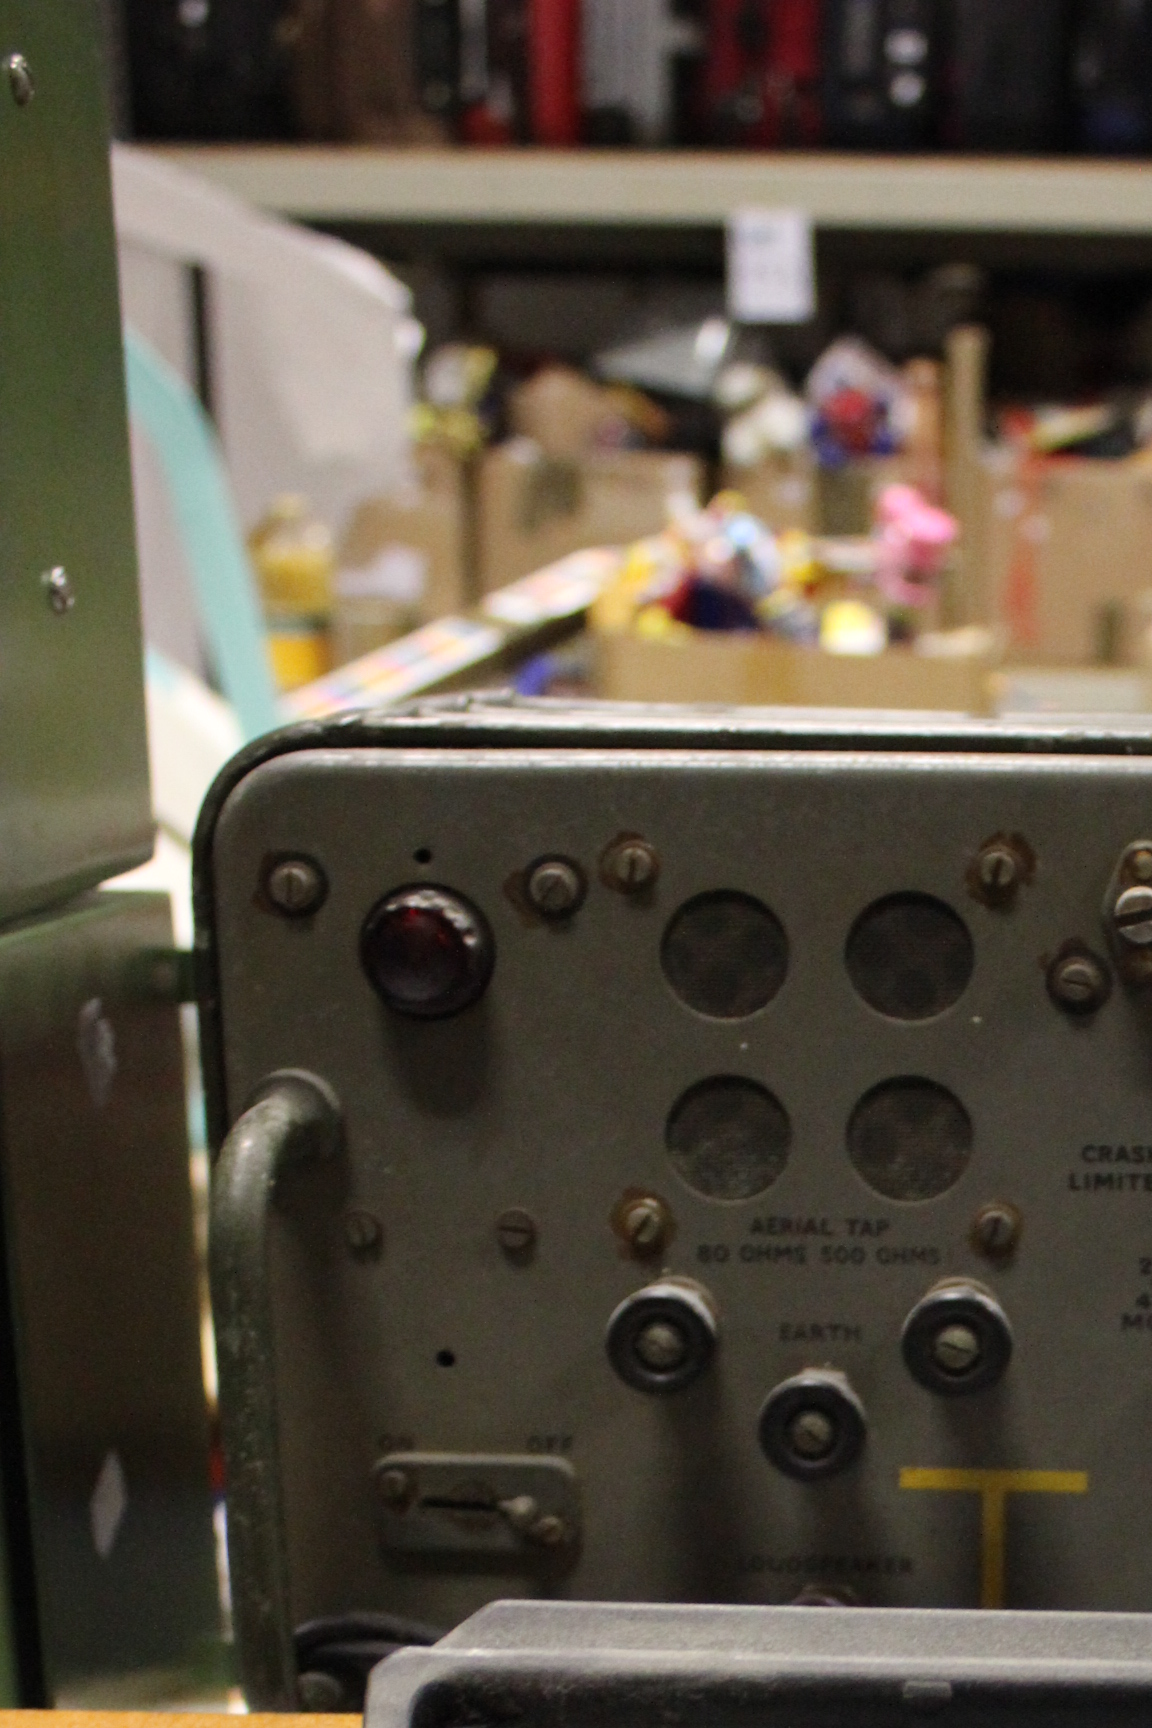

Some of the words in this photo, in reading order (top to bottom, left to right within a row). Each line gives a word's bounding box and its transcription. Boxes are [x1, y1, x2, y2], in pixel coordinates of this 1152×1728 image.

[750, 1216, 834, 1237] AERIAL
[845, 1217, 890, 1237] TAP
[738, 1244, 807, 1265] OHMS
[820, 1245, 866, 1265] 500
[875, 1246, 943, 1266] OHMS
[778, 1322, 862, 1342] EARTH
